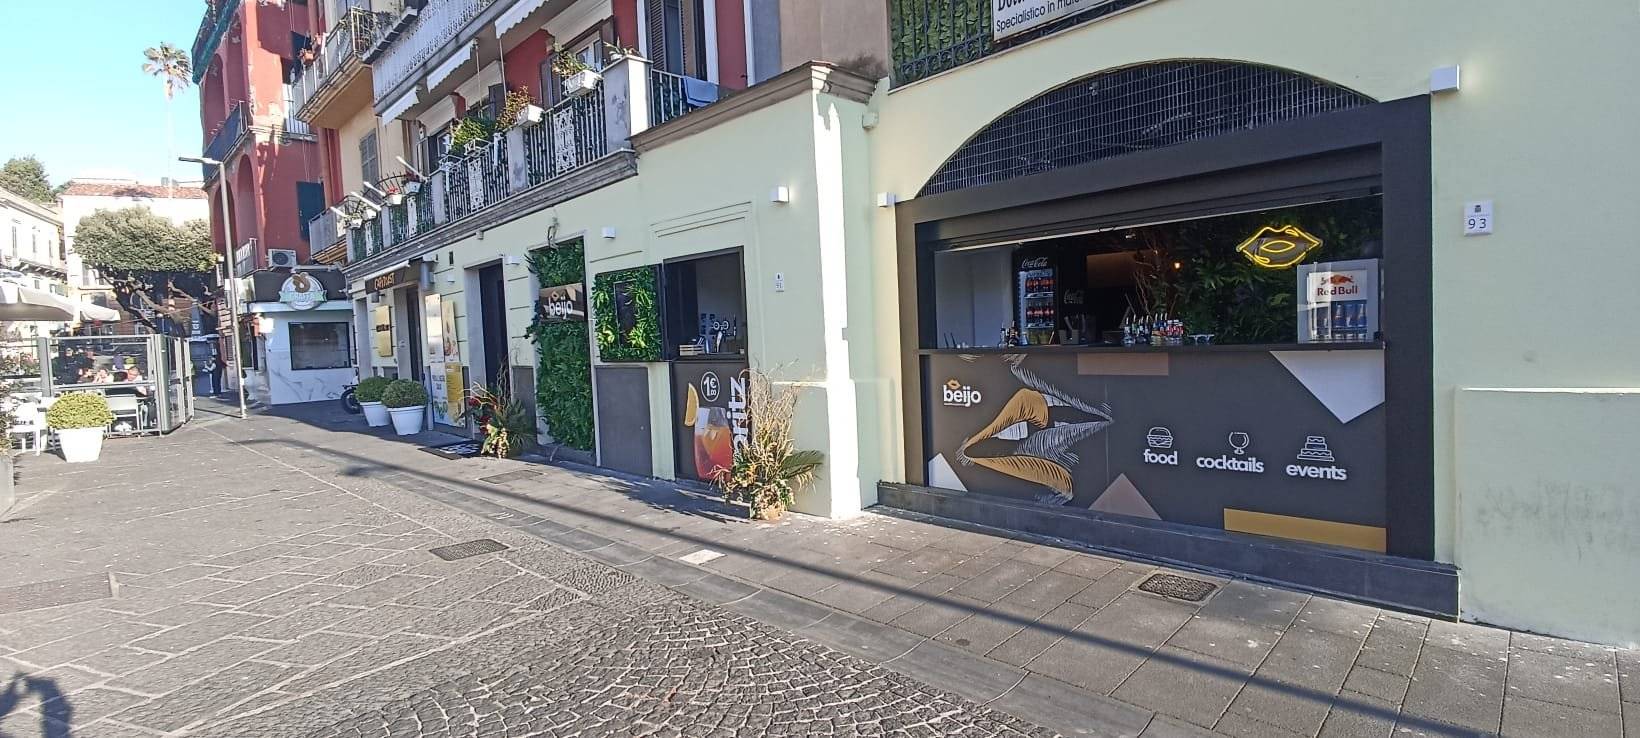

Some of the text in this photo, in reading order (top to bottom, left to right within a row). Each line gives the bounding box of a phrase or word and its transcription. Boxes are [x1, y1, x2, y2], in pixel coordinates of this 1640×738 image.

[996, 6, 1046, 32] Specialistico
[1047, 1, 1055, 13] in
[1468, 218, 1487, 230] 93
[1317, 285, 1358, 297] Red Bull
[548, 296, 573, 320] beijo
[943, 384, 982, 408] beijo
[1143, 448, 1178, 466] food
[1195, 455, 1265, 473] cocktails
[1285, 463, 1348, 481] events
